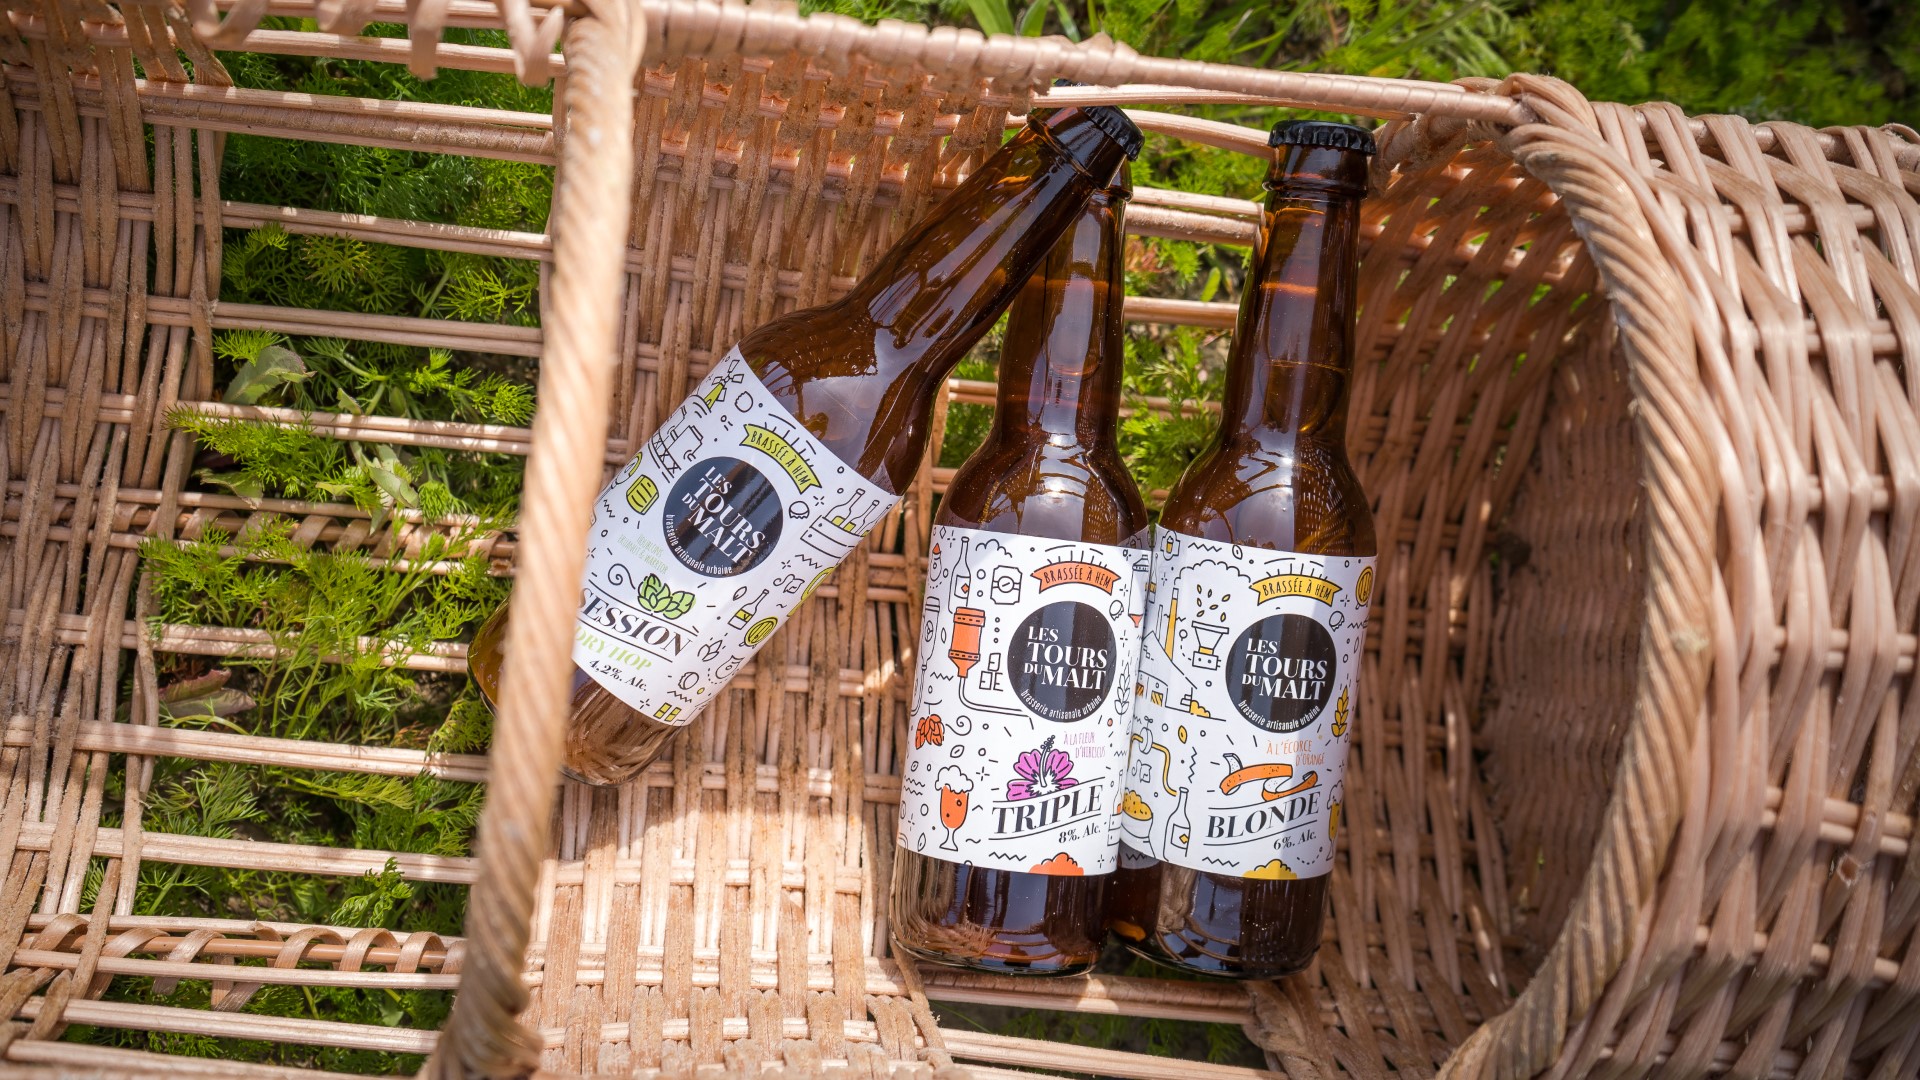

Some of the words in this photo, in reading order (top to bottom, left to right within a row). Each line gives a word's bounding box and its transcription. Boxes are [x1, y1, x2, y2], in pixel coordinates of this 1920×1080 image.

[751, 430, 789, 461] BRASSÉE
[786, 455, 798, 467] À
[792, 465, 811, 485] HEM
[705, 466, 733, 495] LES
[681, 492, 701, 511] DU
[694, 477, 766, 549] TOURS
[666, 514, 679, 546] brasserie
[674, 545, 705, 571] artisanale
[706, 564, 733, 575] urbaine
[688, 506, 753, 563] MALT
[1043, 565, 1083, 584] BRASSÉE
[1086, 566, 1093, 581] À
[1095, 572, 1111, 588] HEM
[1262, 577, 1302, 597] BRASSÉE
[1306, 579, 1312, 594] À
[1315, 584, 1332, 600] HEM
[1028, 626, 1059, 642] LES
[1246, 638, 1278, 654] LES
[607, 644, 653, 670] HOP
[1027, 641, 1108, 669] TOURS
[1245, 653, 1328, 680] TOURS
[625, 676, 647, 691] Alc.
[1024, 662, 1043, 675] DU
[1041, 665, 1106, 690] MALT
[1241, 673, 1261, 687] DU
[1259, 676, 1326, 700] MALT
[1021, 689, 1048, 715] brasserie
[1049, 708, 1082, 720] artisanale
[1081, 695, 1102, 715] urbaine
[1238, 700, 1266, 726] brasserie
[1266, 719, 1300, 731] artisanale
[1299, 705, 1321, 726] urbaine
[991, 784, 1104, 834] TRIPLE
[1205, 791, 1321, 839] BLONDE
[1082, 822, 1101, 838] Alc.
[1297, 829, 1317, 845] Alc.
